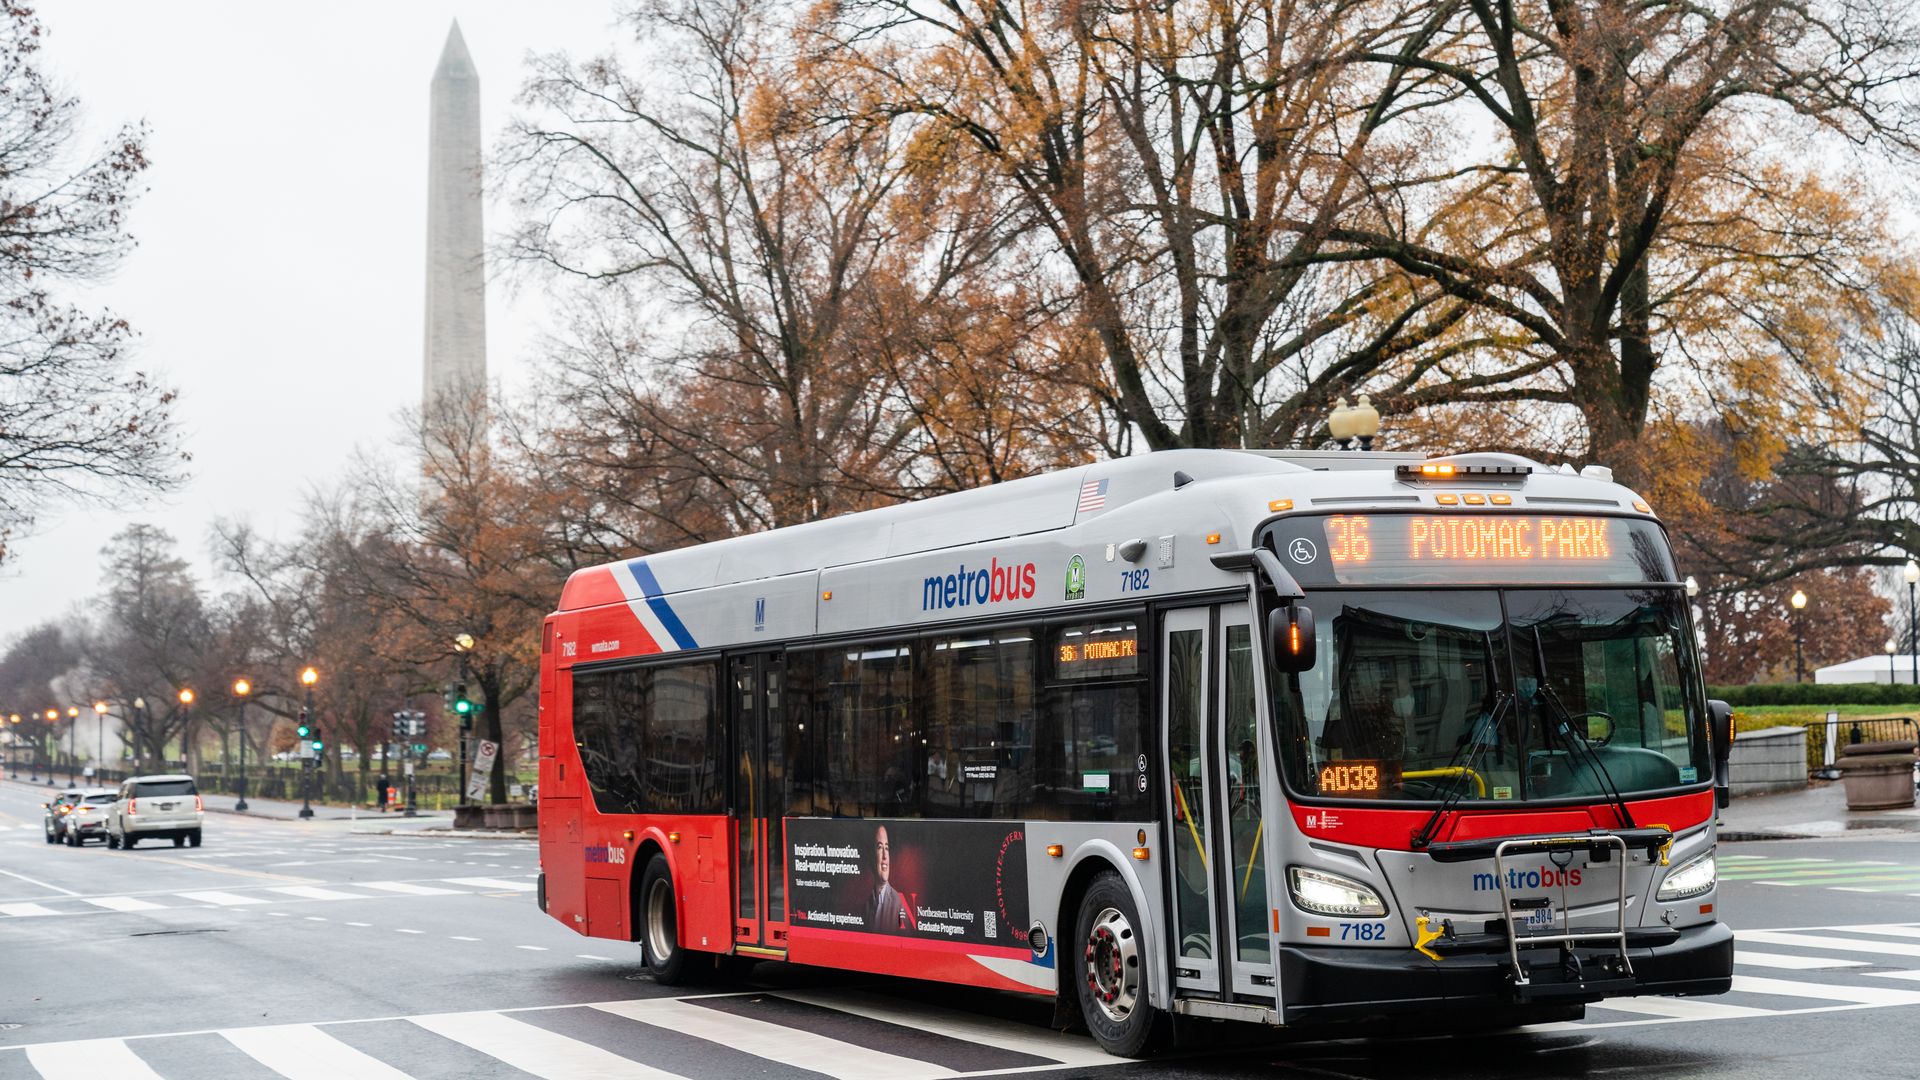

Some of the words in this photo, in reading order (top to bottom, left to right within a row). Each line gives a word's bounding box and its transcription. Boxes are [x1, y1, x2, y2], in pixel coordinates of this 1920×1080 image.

[1329, 517, 1369, 560] 36
[1412, 518, 1531, 559] POTOMAC
[1541, 518, 1610, 559] PARK
[923, 557, 1036, 611] metrobus
[1121, 568, 1150, 592] 7182
[562, 641, 577, 657] 7182
[591, 640, 620, 653] wmata.com
[1060, 645, 1073, 662] 36
[1084, 641, 1120, 660] POTOMAC
[1121, 639, 1134, 657] PK
[585, 841, 625, 864] metrobus
[794, 843, 827, 858] Inspiration.
[827, 844, 861, 858] Innovation.
[795, 859, 826, 872] Real-world
[826, 861, 861, 875] experience.
[996, 831, 1024, 919] NORTHEASTERN
[1473, 865, 1582, 891] metrobus
[807, 910, 829, 922] Activated
[829, 912, 836, 924] by
[836, 913, 864, 925] experience.
[917, 906, 948, 918] Northeastern
[949, 908, 974, 923] University
[917, 920, 940, 933] Graduate
[940, 923, 965, 935] Programs
[1011, 926, 1028, 940] 1898
[1340, 923, 1386, 940] 7182
